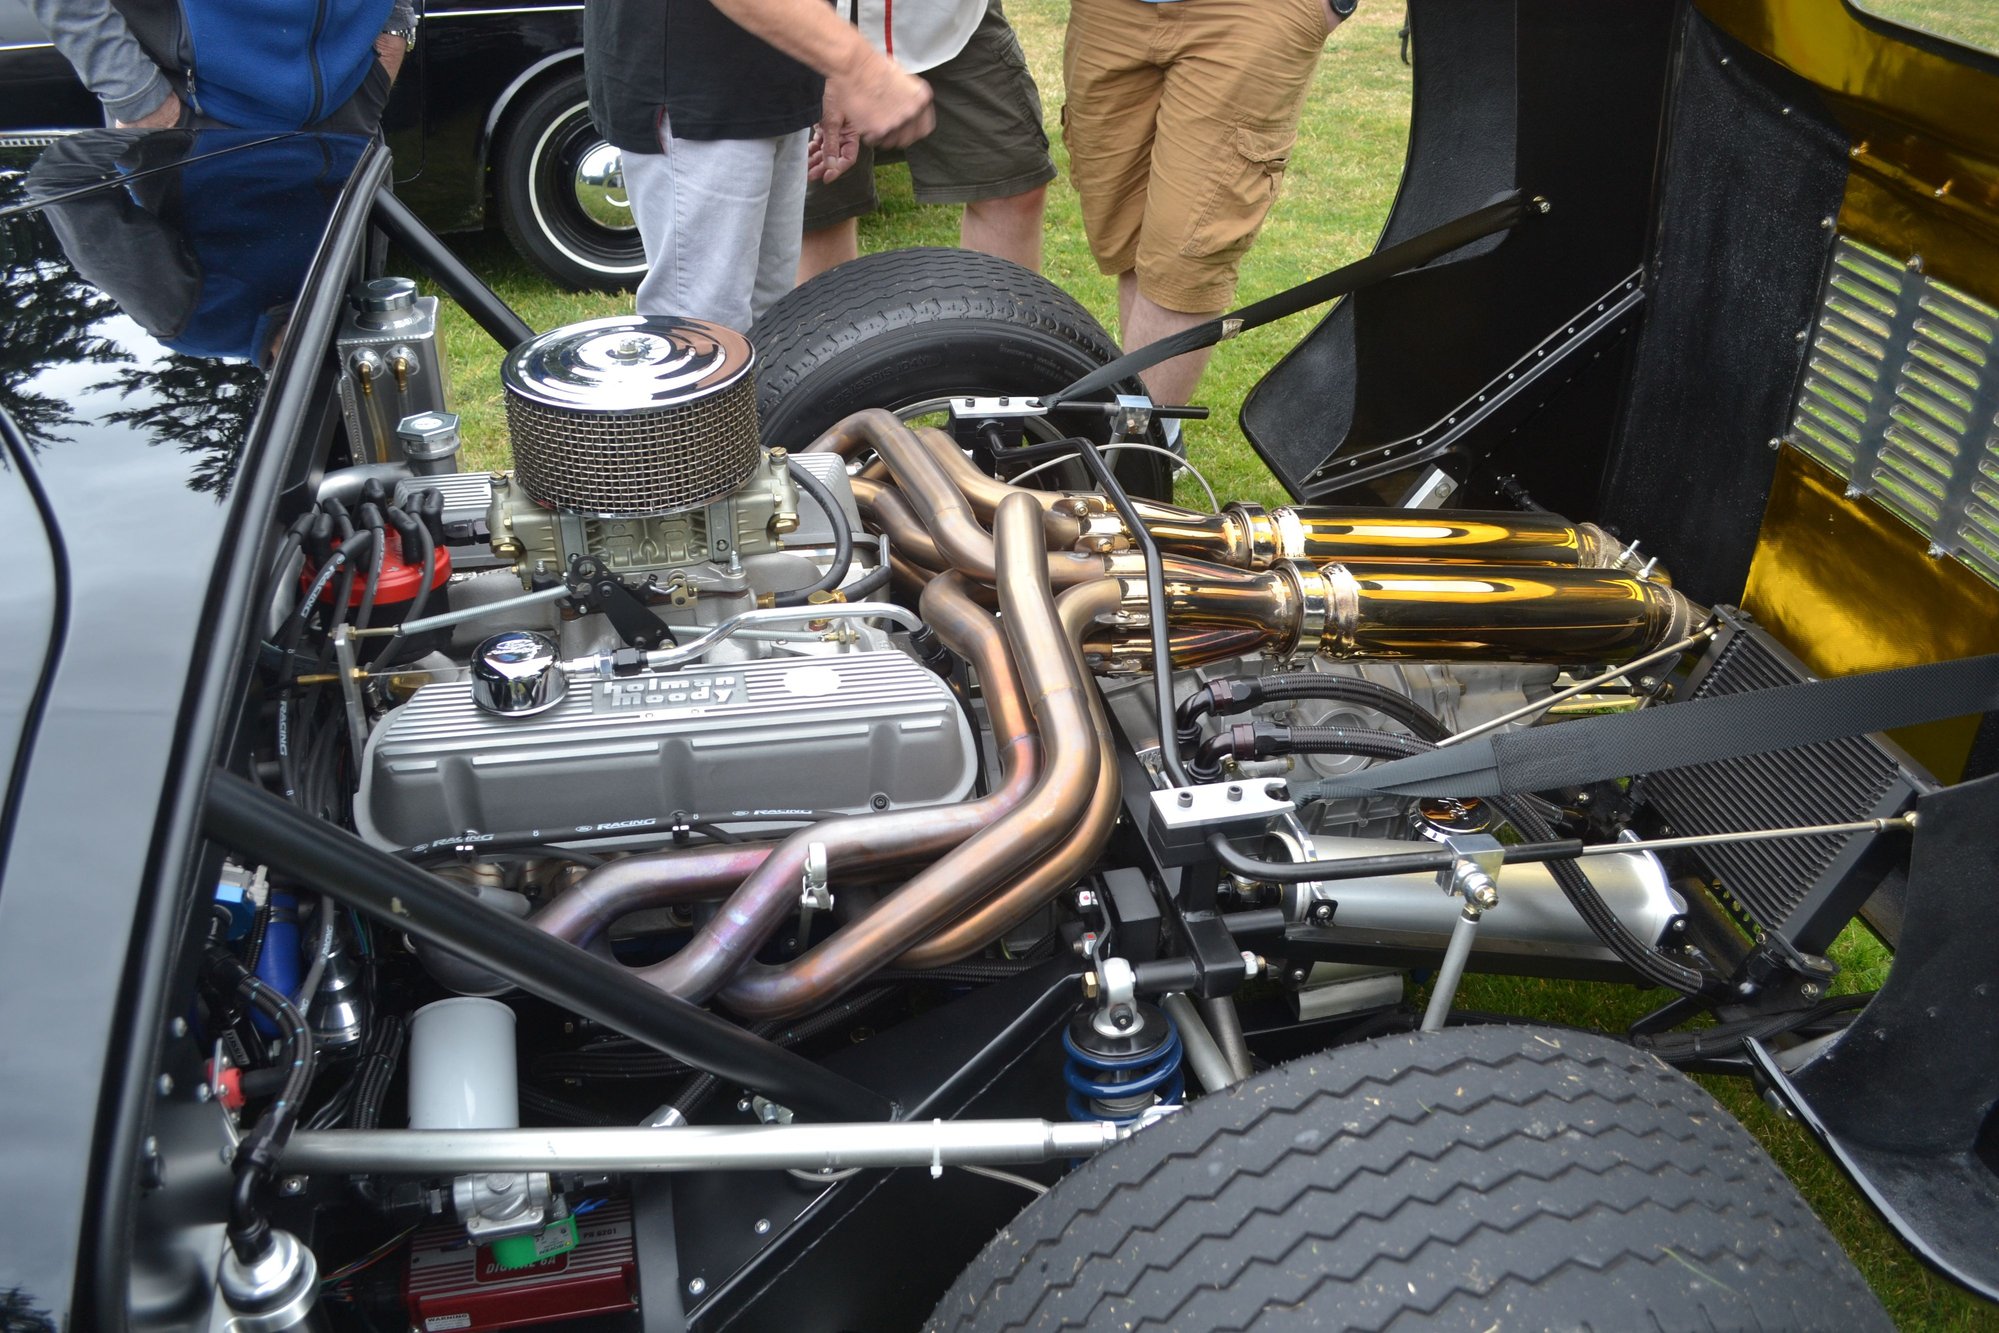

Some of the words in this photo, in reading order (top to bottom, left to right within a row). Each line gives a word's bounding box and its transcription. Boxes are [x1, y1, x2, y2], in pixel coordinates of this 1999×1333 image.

[301, 565, 336, 618] RACING
[603, 676, 735, 694] holman
[611, 686, 733, 706] moody
[280, 700, 288, 756] RACING
[597, 818, 656, 830] RACING
[432, 833, 495, 847] RACING
[428, 1314, 468, 1322] WARNING
